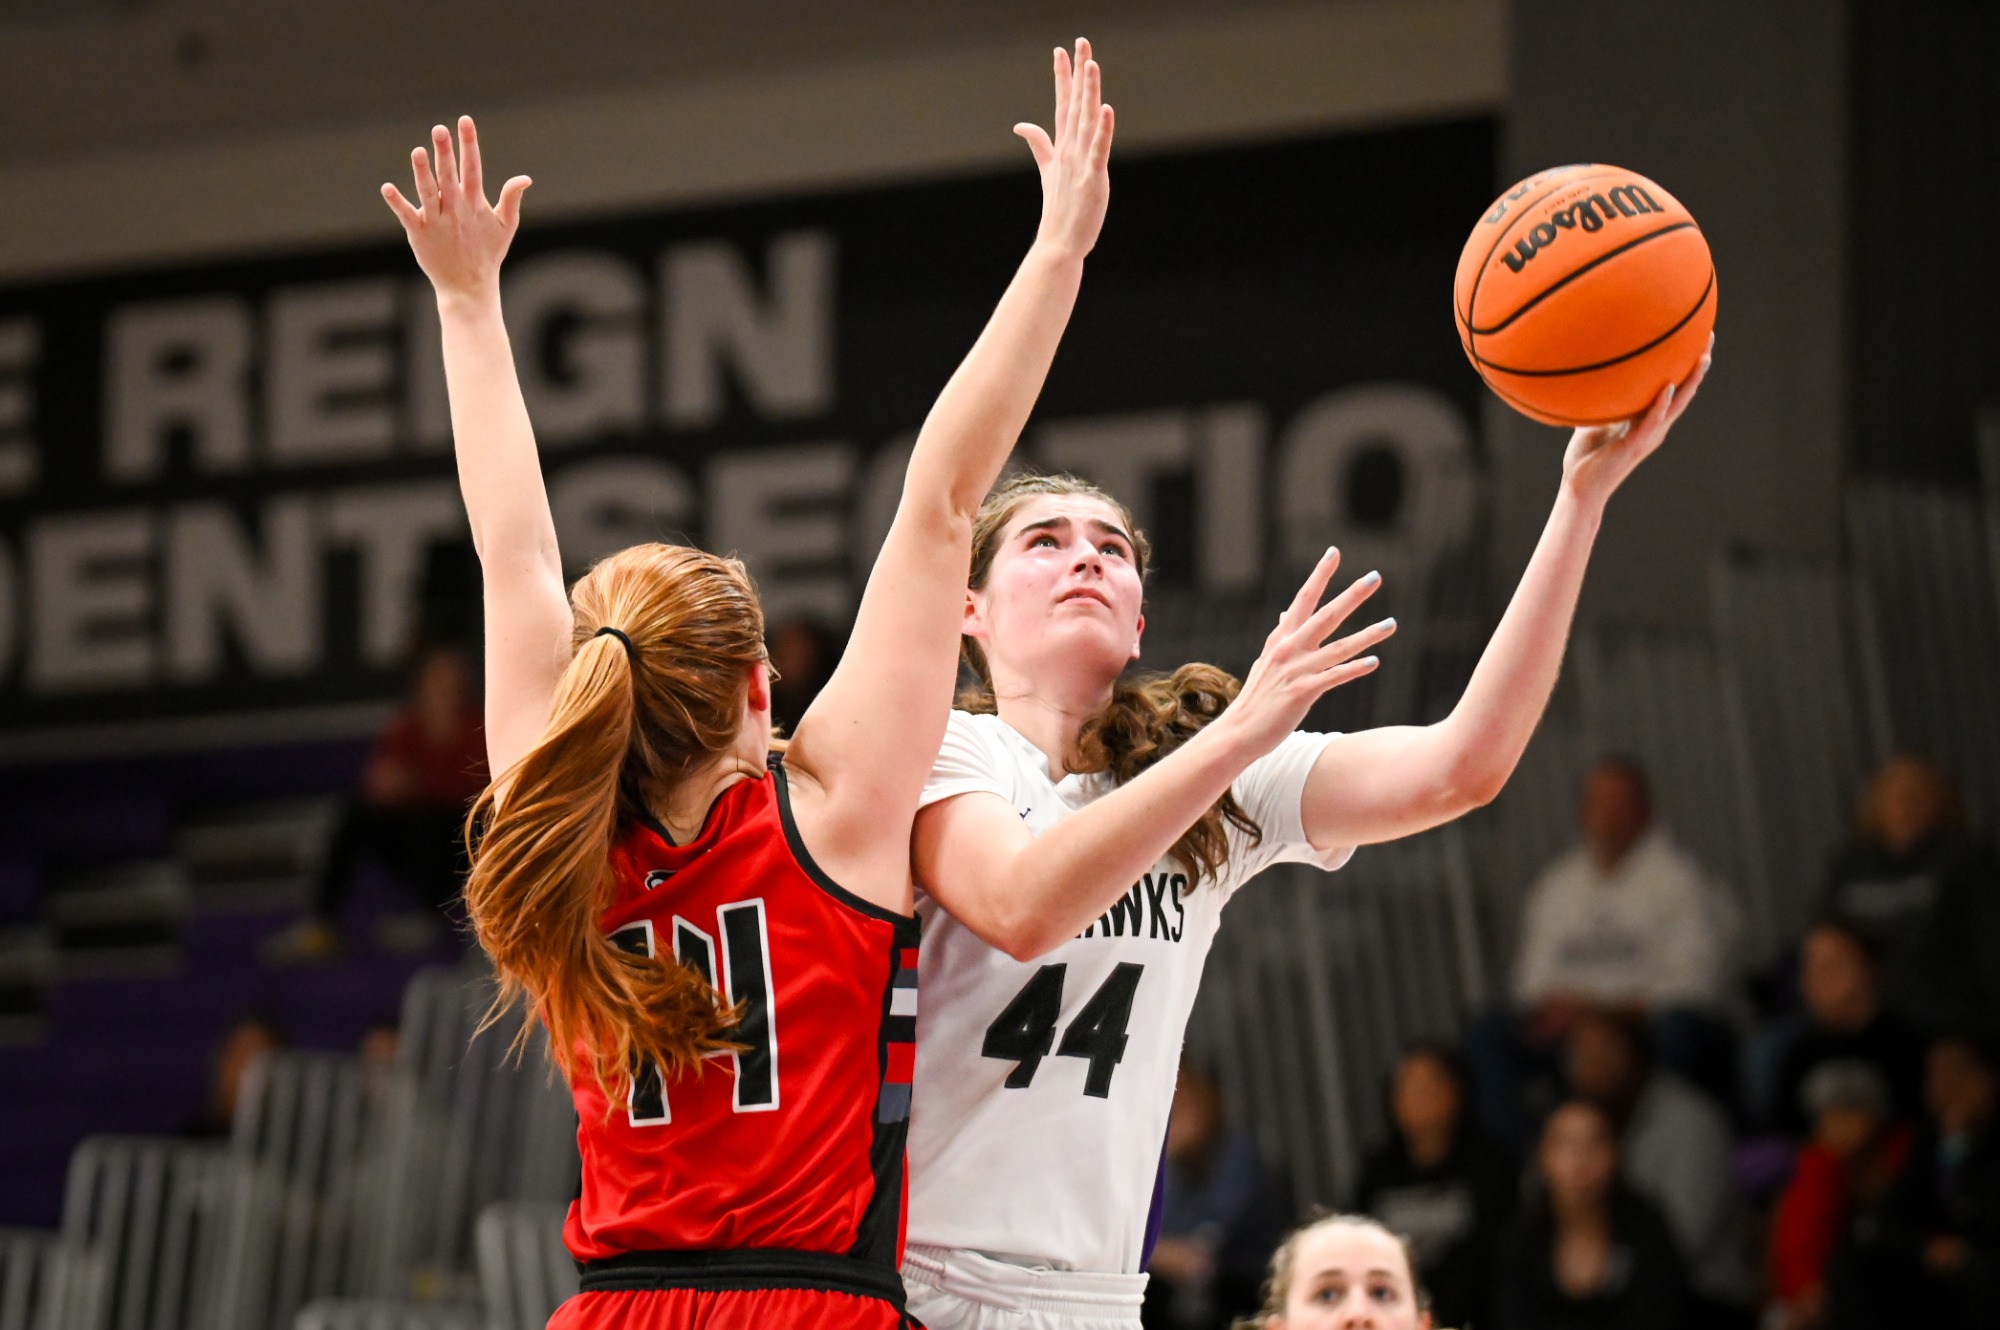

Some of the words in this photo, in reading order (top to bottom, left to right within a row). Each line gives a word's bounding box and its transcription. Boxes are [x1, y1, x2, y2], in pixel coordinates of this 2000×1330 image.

[1500, 184, 1665, 274] Wilson
[0, 478, 466, 694] ENT
[981, 961, 1144, 1099] 44
